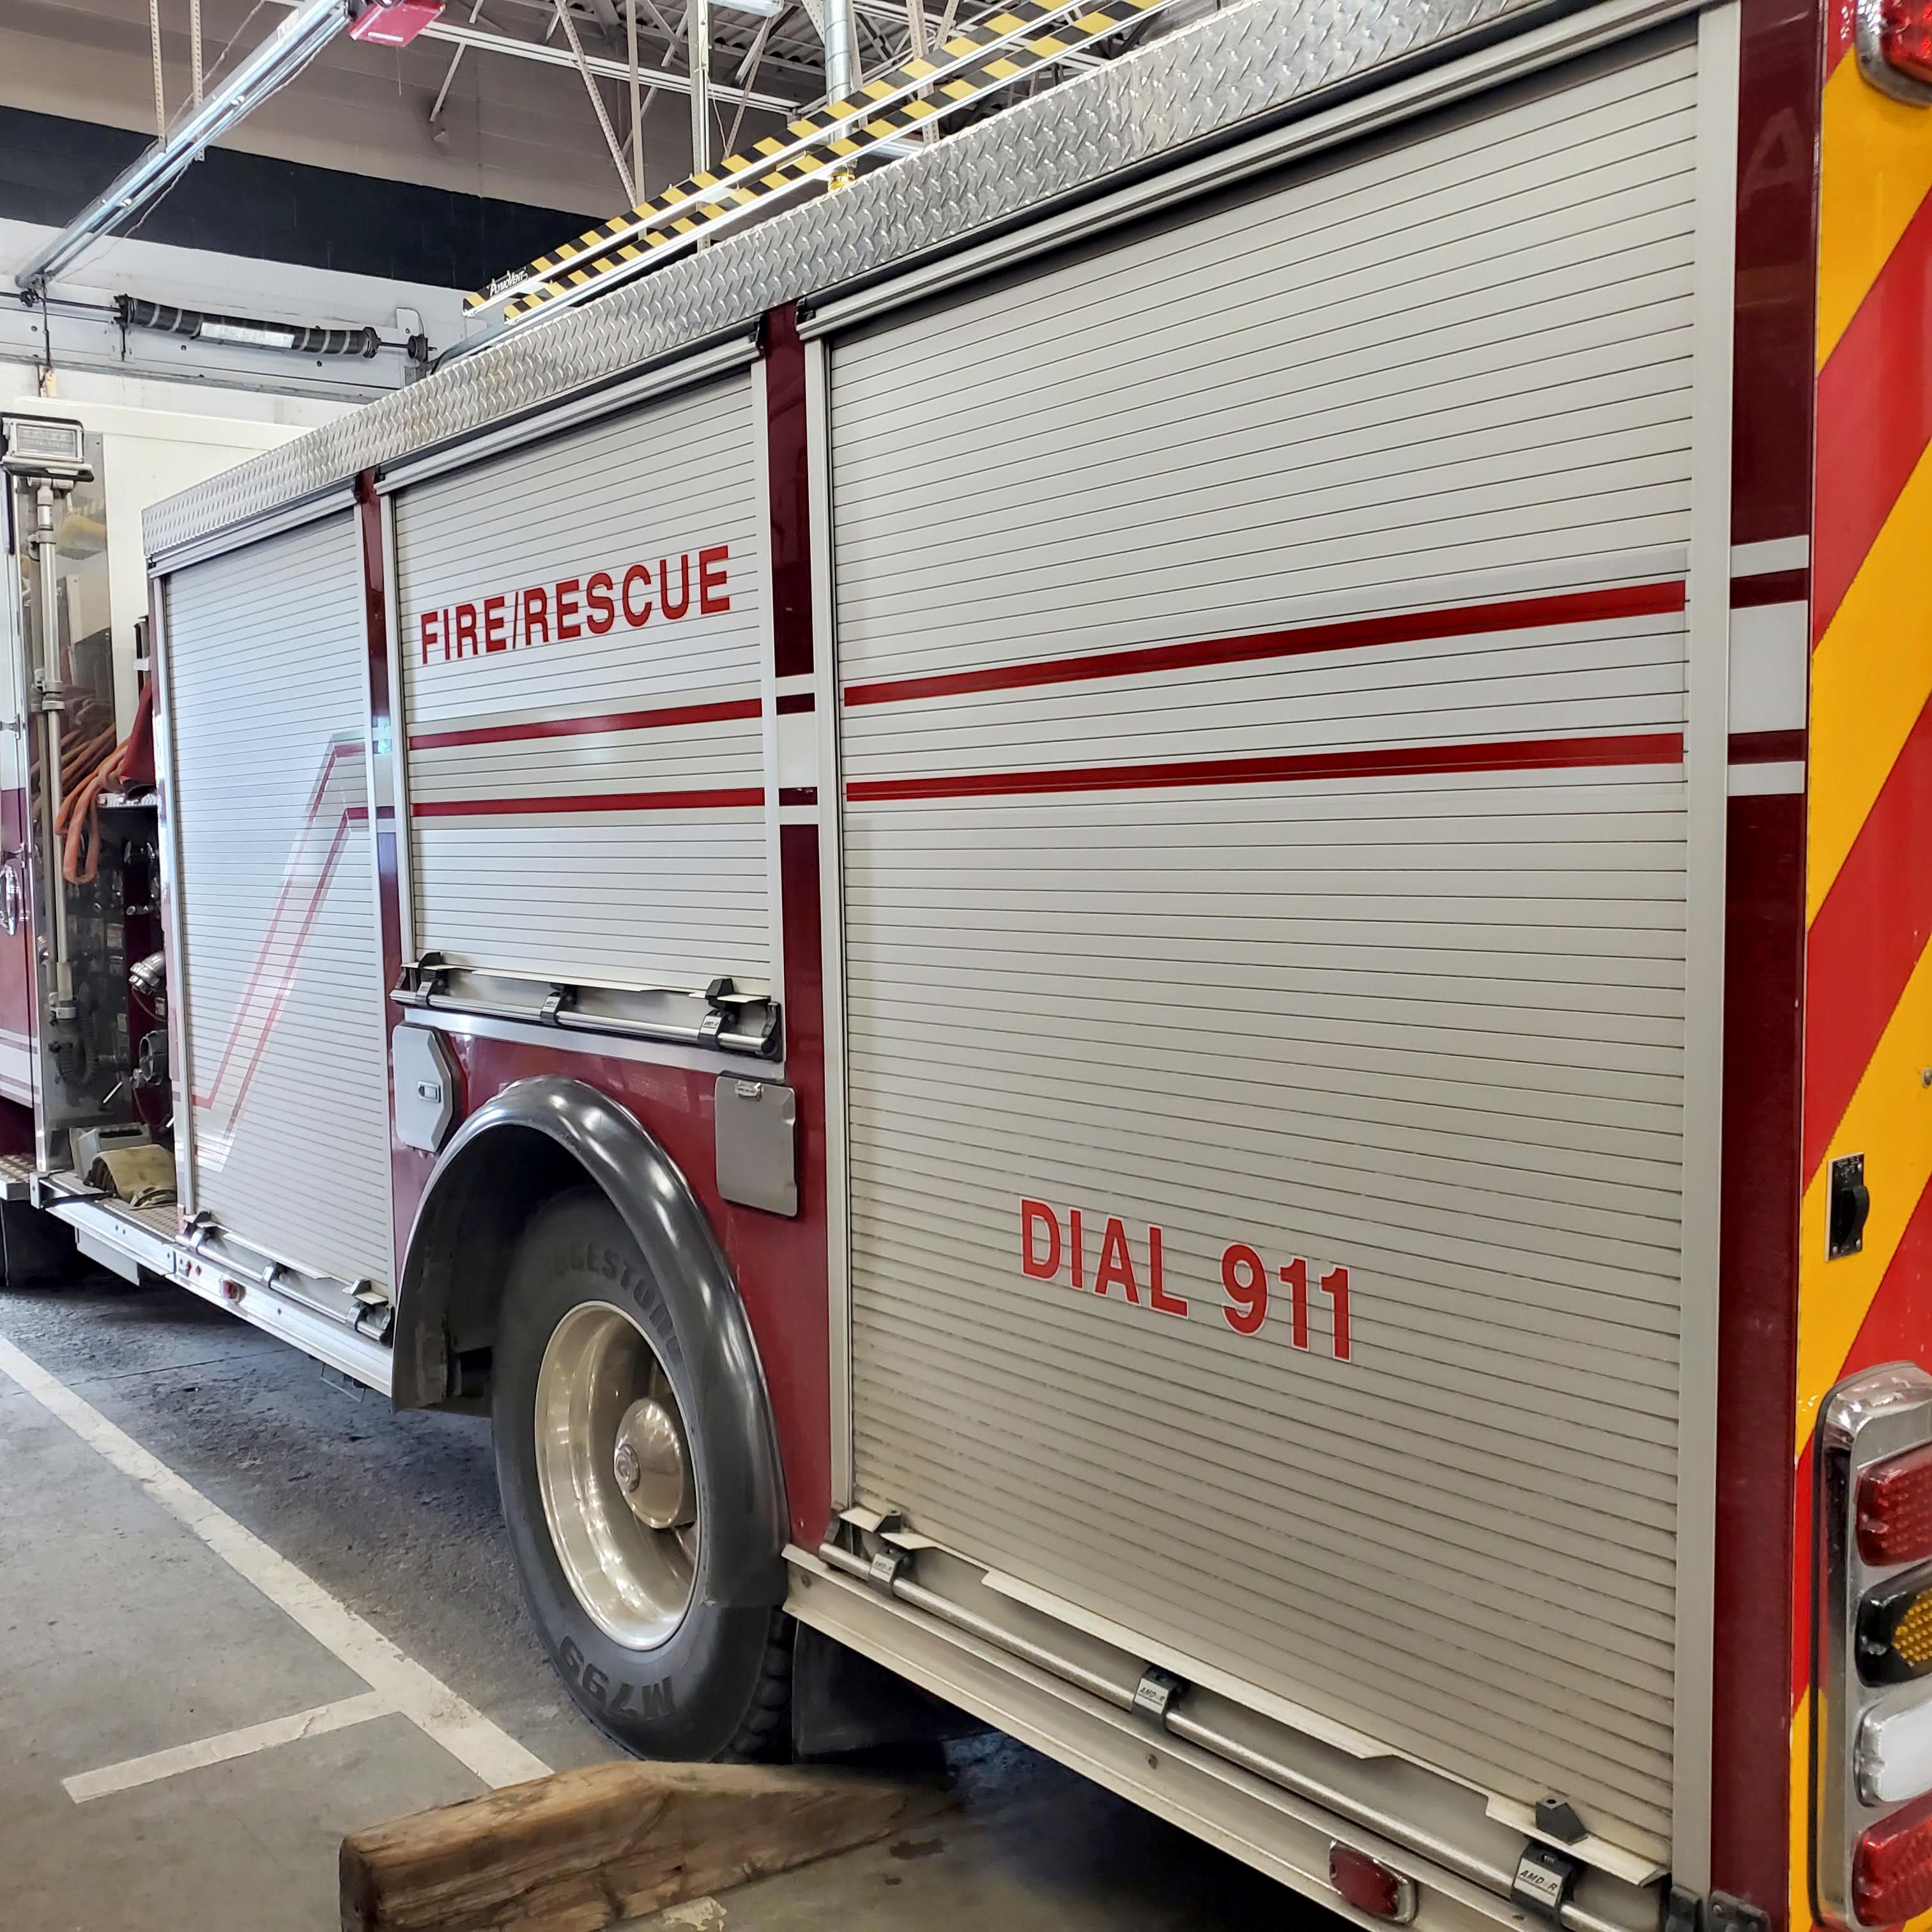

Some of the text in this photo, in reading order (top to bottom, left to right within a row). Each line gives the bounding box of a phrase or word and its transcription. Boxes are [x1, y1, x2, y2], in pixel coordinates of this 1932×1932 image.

[420, 544, 731, 664] FIRE/RESCUE
[1020, 1197, 1351, 1361] DIAL 911
[1139, 1687, 1166, 1703] AMDR
[1519, 1870, 1558, 1891] AMDR
